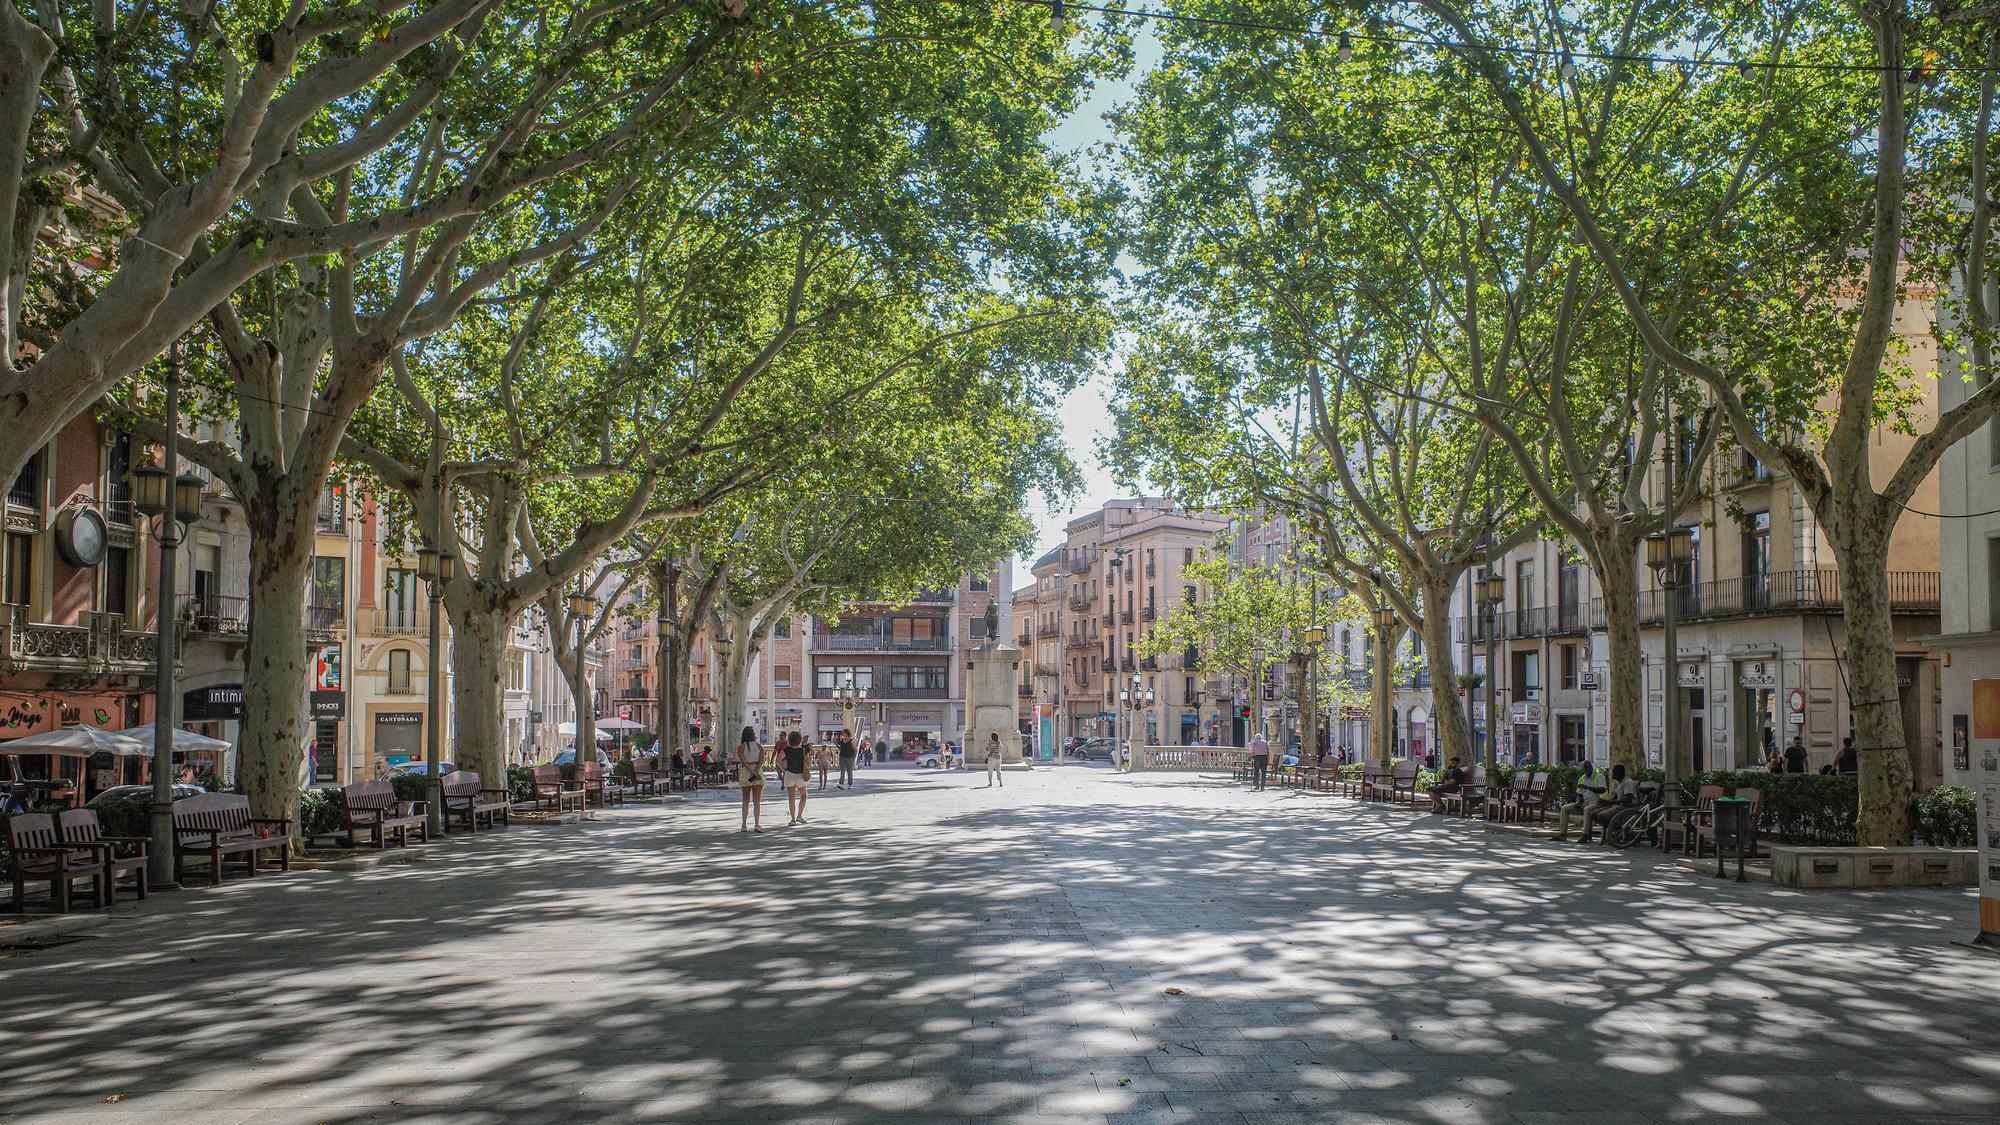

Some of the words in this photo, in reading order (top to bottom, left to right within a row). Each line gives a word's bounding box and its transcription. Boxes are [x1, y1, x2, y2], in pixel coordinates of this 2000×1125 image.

[1264, 655, 1273, 700] OTEL
[61, 707, 80, 721] BAR
[901, 713, 930, 721] origens
